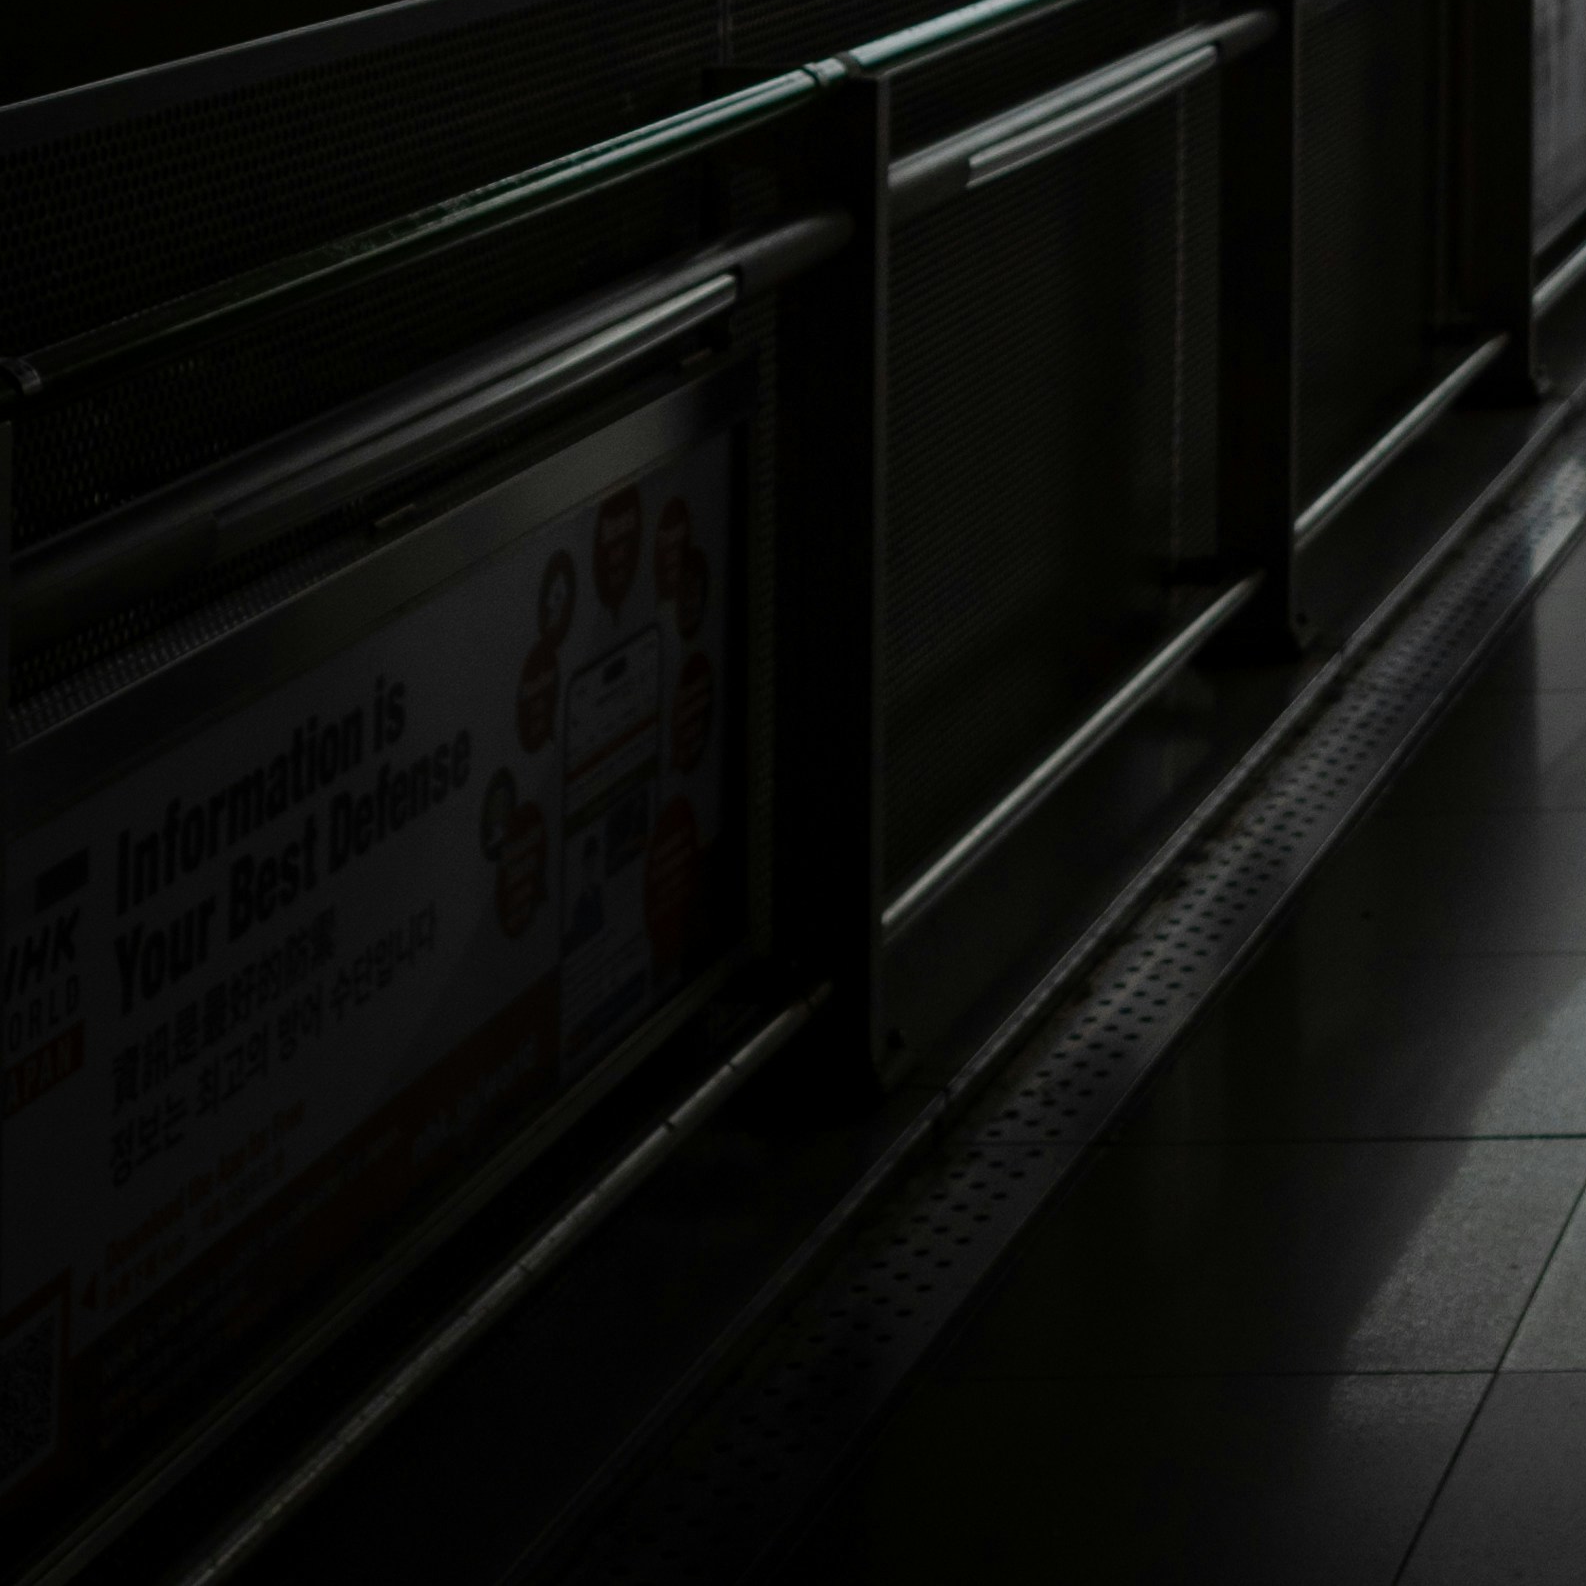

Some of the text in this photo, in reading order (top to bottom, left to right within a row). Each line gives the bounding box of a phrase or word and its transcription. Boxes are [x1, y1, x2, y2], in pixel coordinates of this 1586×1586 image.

[114, 895, 216, 1016] Your
[228, 813, 317, 943] Best
[329, 729, 471, 875] Defense
[116, 705, 363, 917] Information
[374, 673, 405, 753] is
